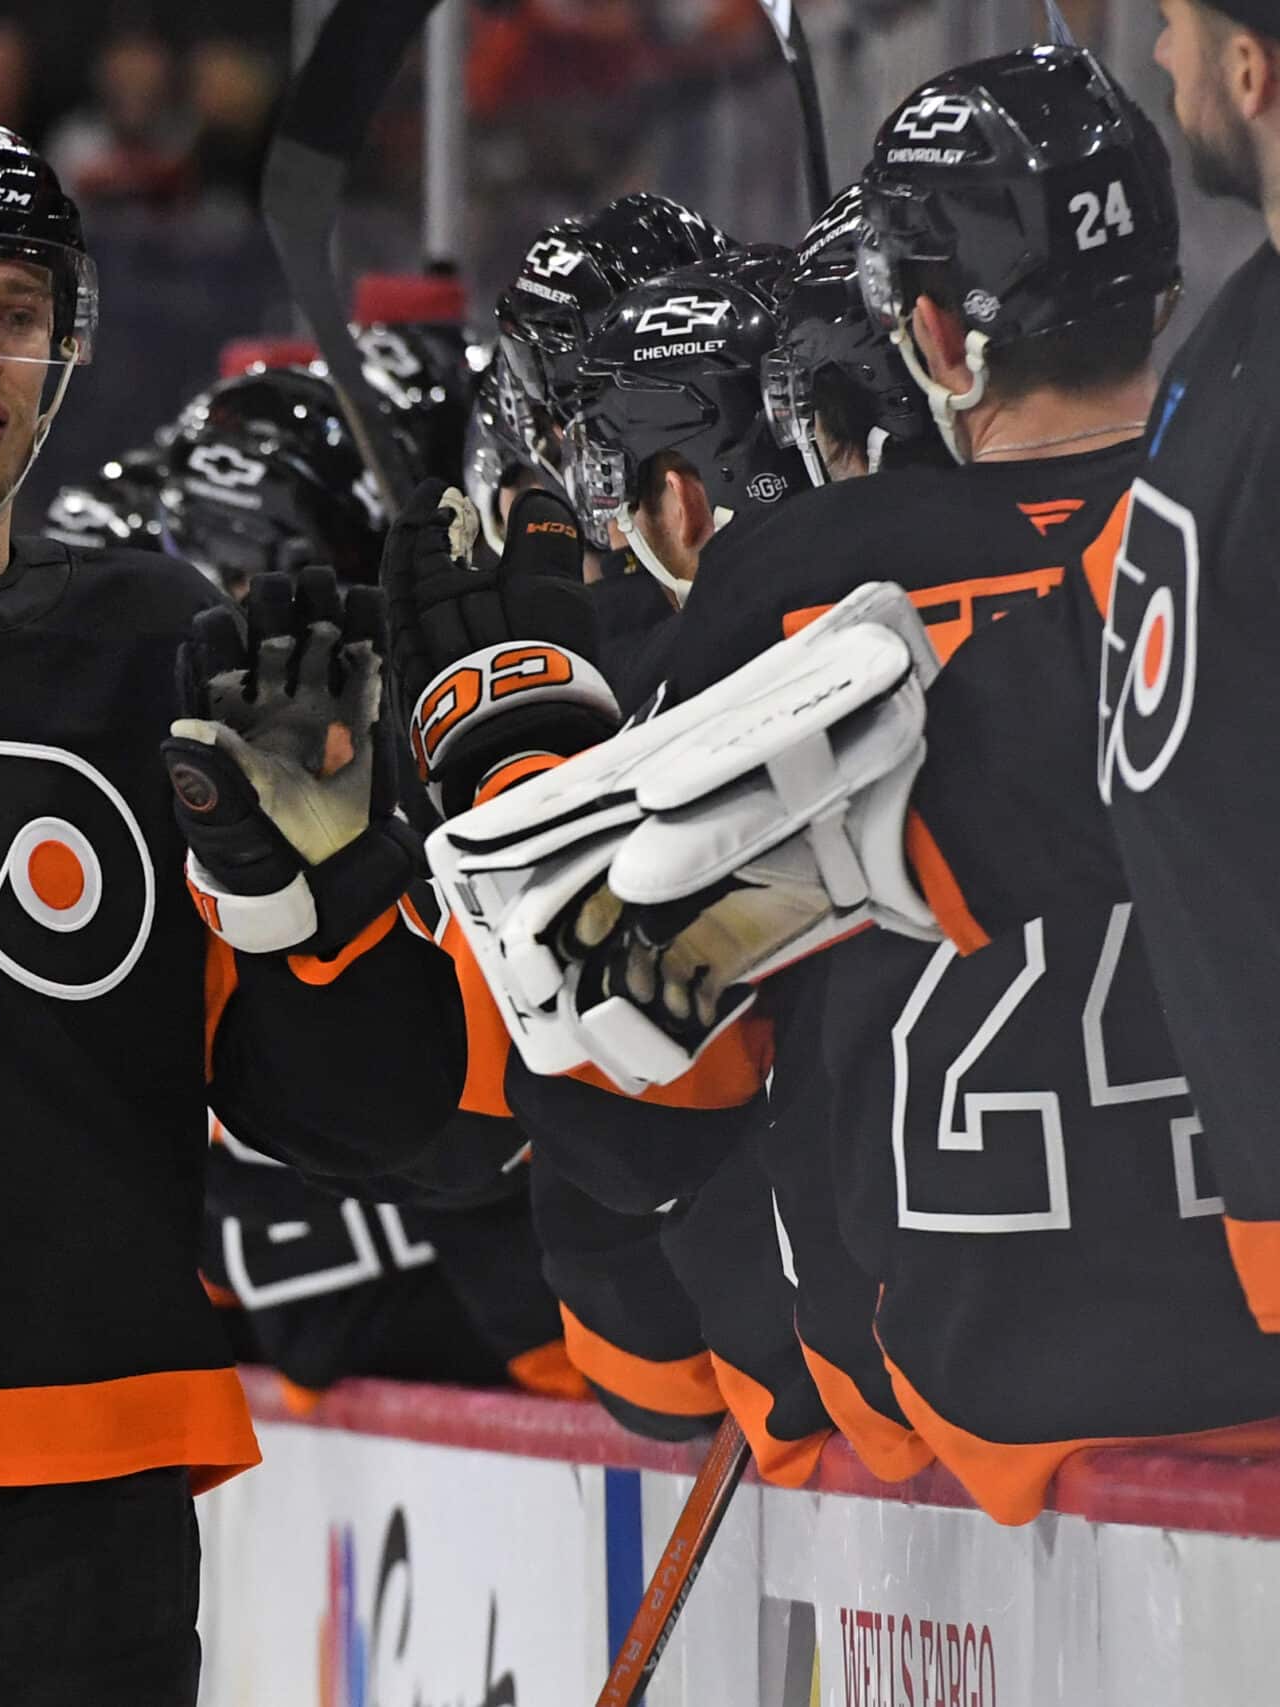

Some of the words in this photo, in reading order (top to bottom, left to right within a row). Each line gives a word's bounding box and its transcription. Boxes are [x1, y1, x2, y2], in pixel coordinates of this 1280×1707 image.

[1068, 180, 1135, 251] 24
[633, 340, 727, 362] CHEVROLET
[410, 646, 573, 782] CC
[841, 1607, 916, 1707] WELLS
[919, 1619, 996, 1707] FARGO
